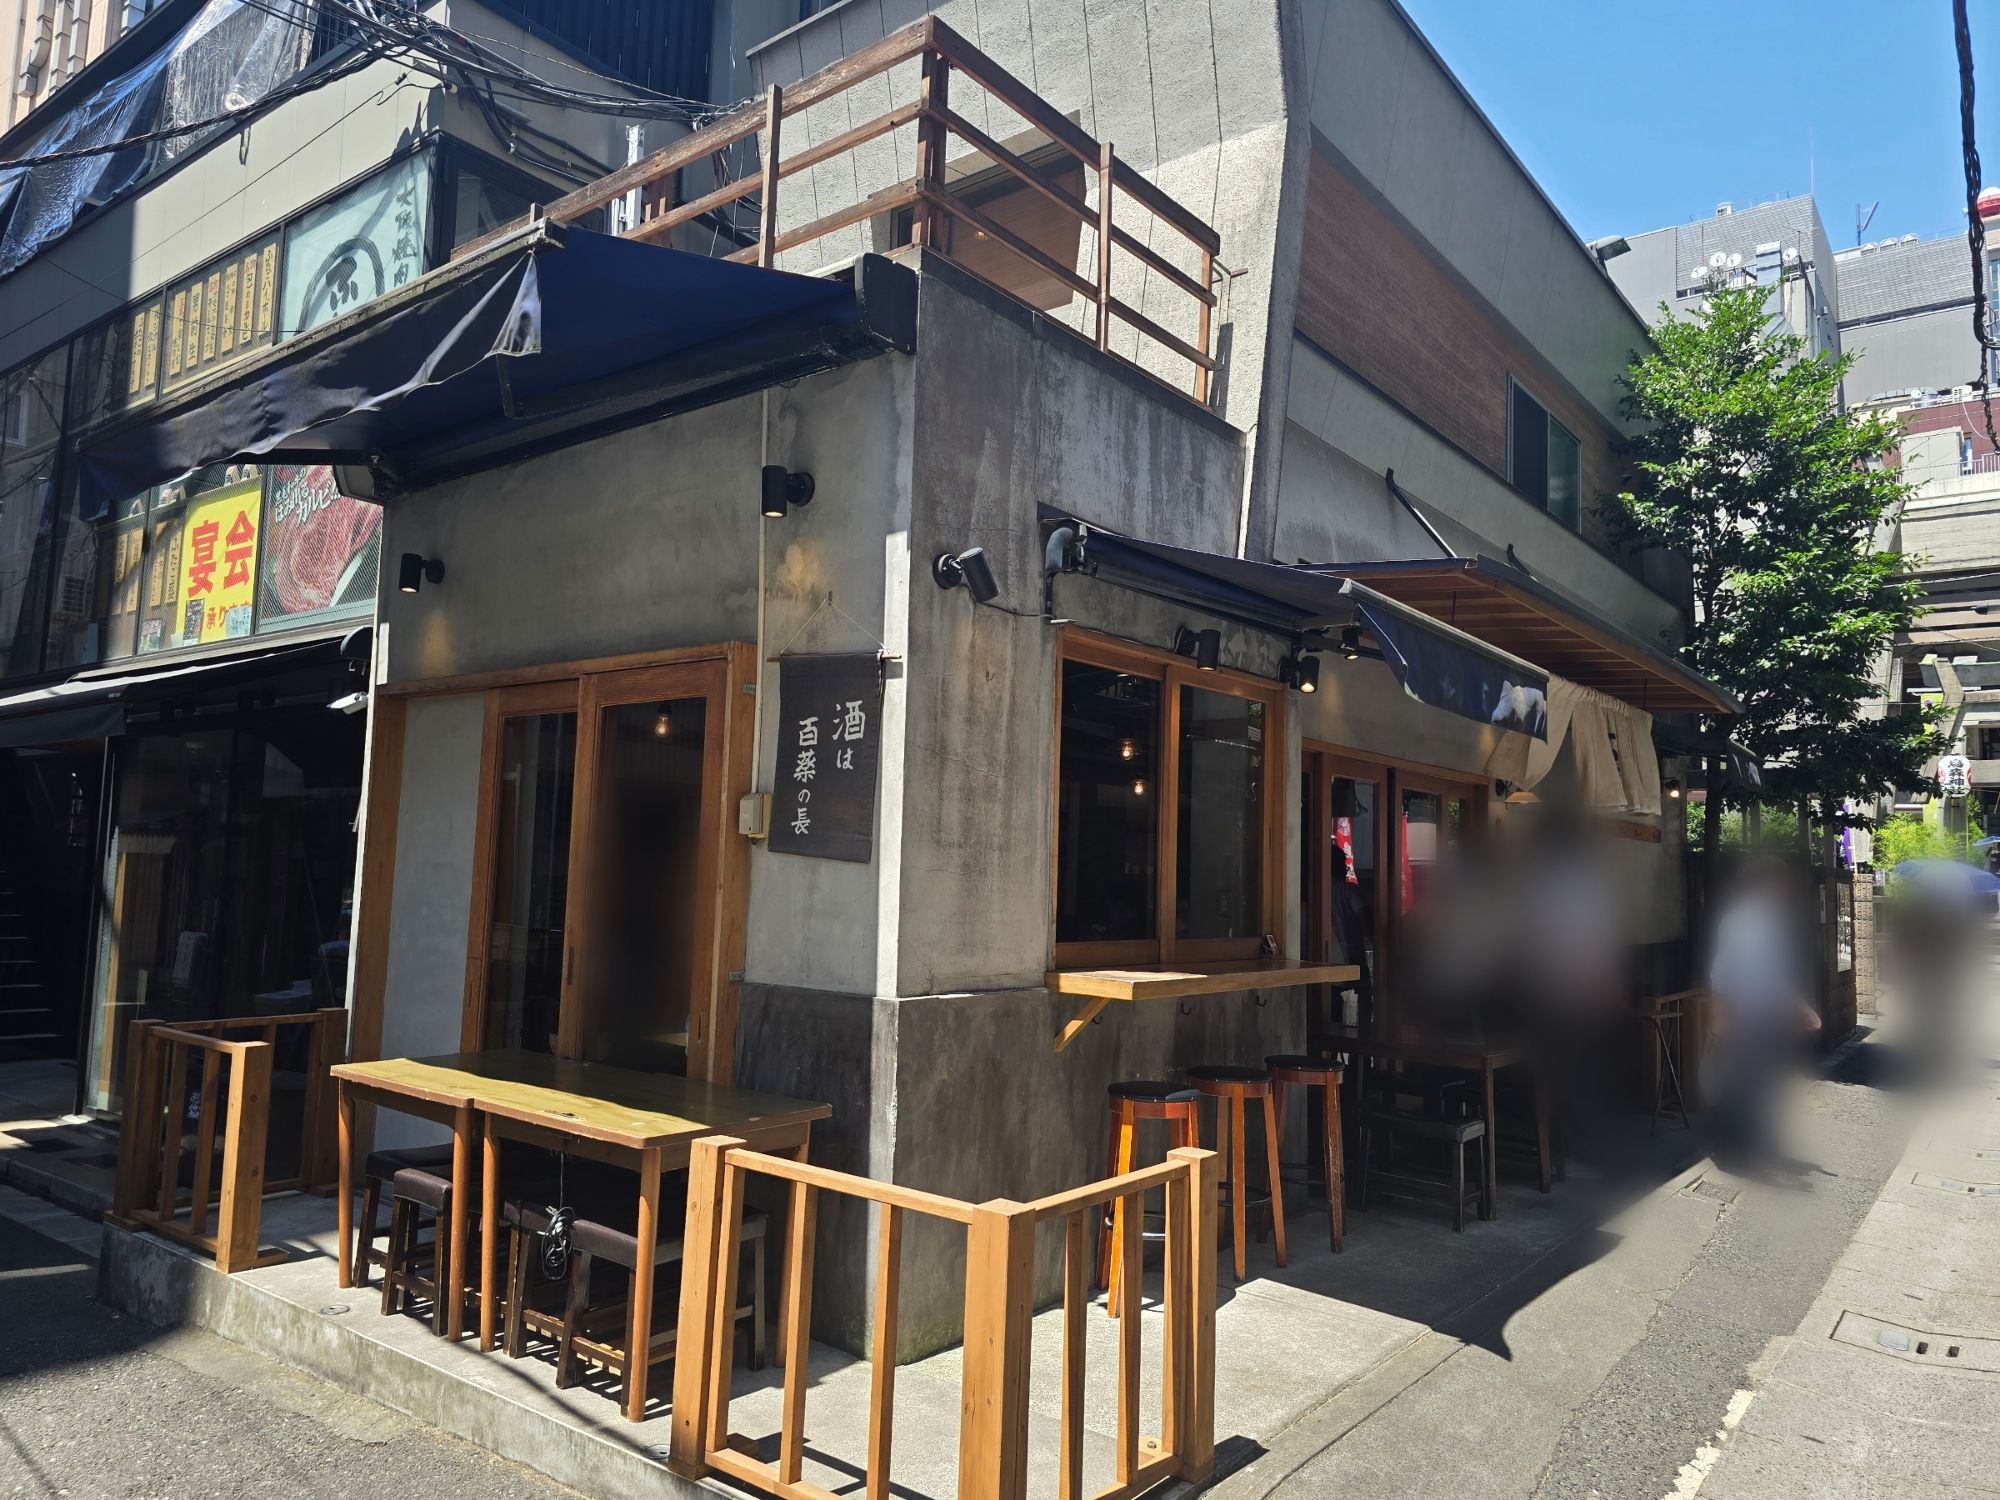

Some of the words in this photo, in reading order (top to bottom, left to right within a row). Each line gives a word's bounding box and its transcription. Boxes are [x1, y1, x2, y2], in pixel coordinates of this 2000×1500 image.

[187, 510, 256, 598] 宴会
[790, 716, 819, 835] 百薬の長
[832, 700, 866, 770] 酒は
